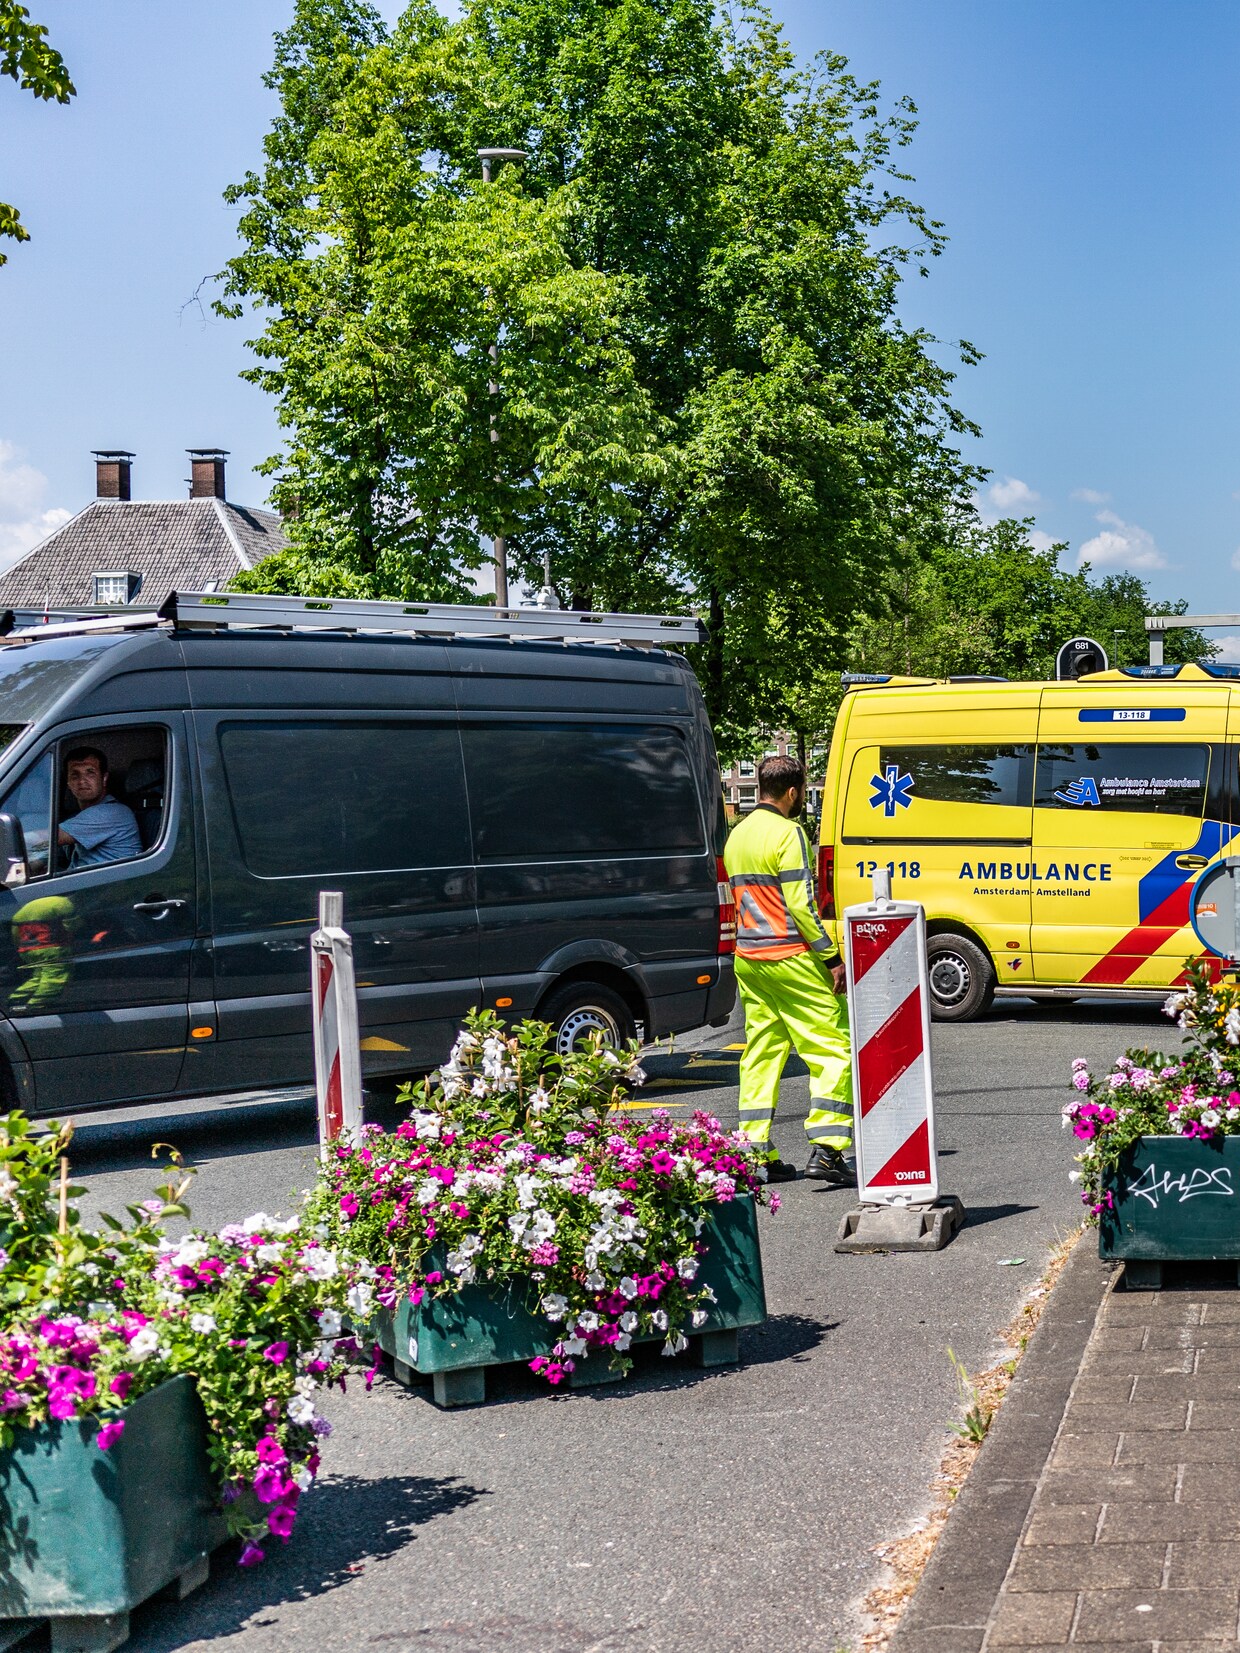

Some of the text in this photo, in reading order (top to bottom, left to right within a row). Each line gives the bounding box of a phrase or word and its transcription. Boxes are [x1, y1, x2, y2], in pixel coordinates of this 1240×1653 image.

[1075, 642, 1089, 650] 681
[1100, 777, 1200, 787] Ambulance Amsterdam
[1102, 788, 1116, 796] zorg
[1127, 788, 1145, 796] hoofd
[958, 862, 1112, 881] AMBULANCE
